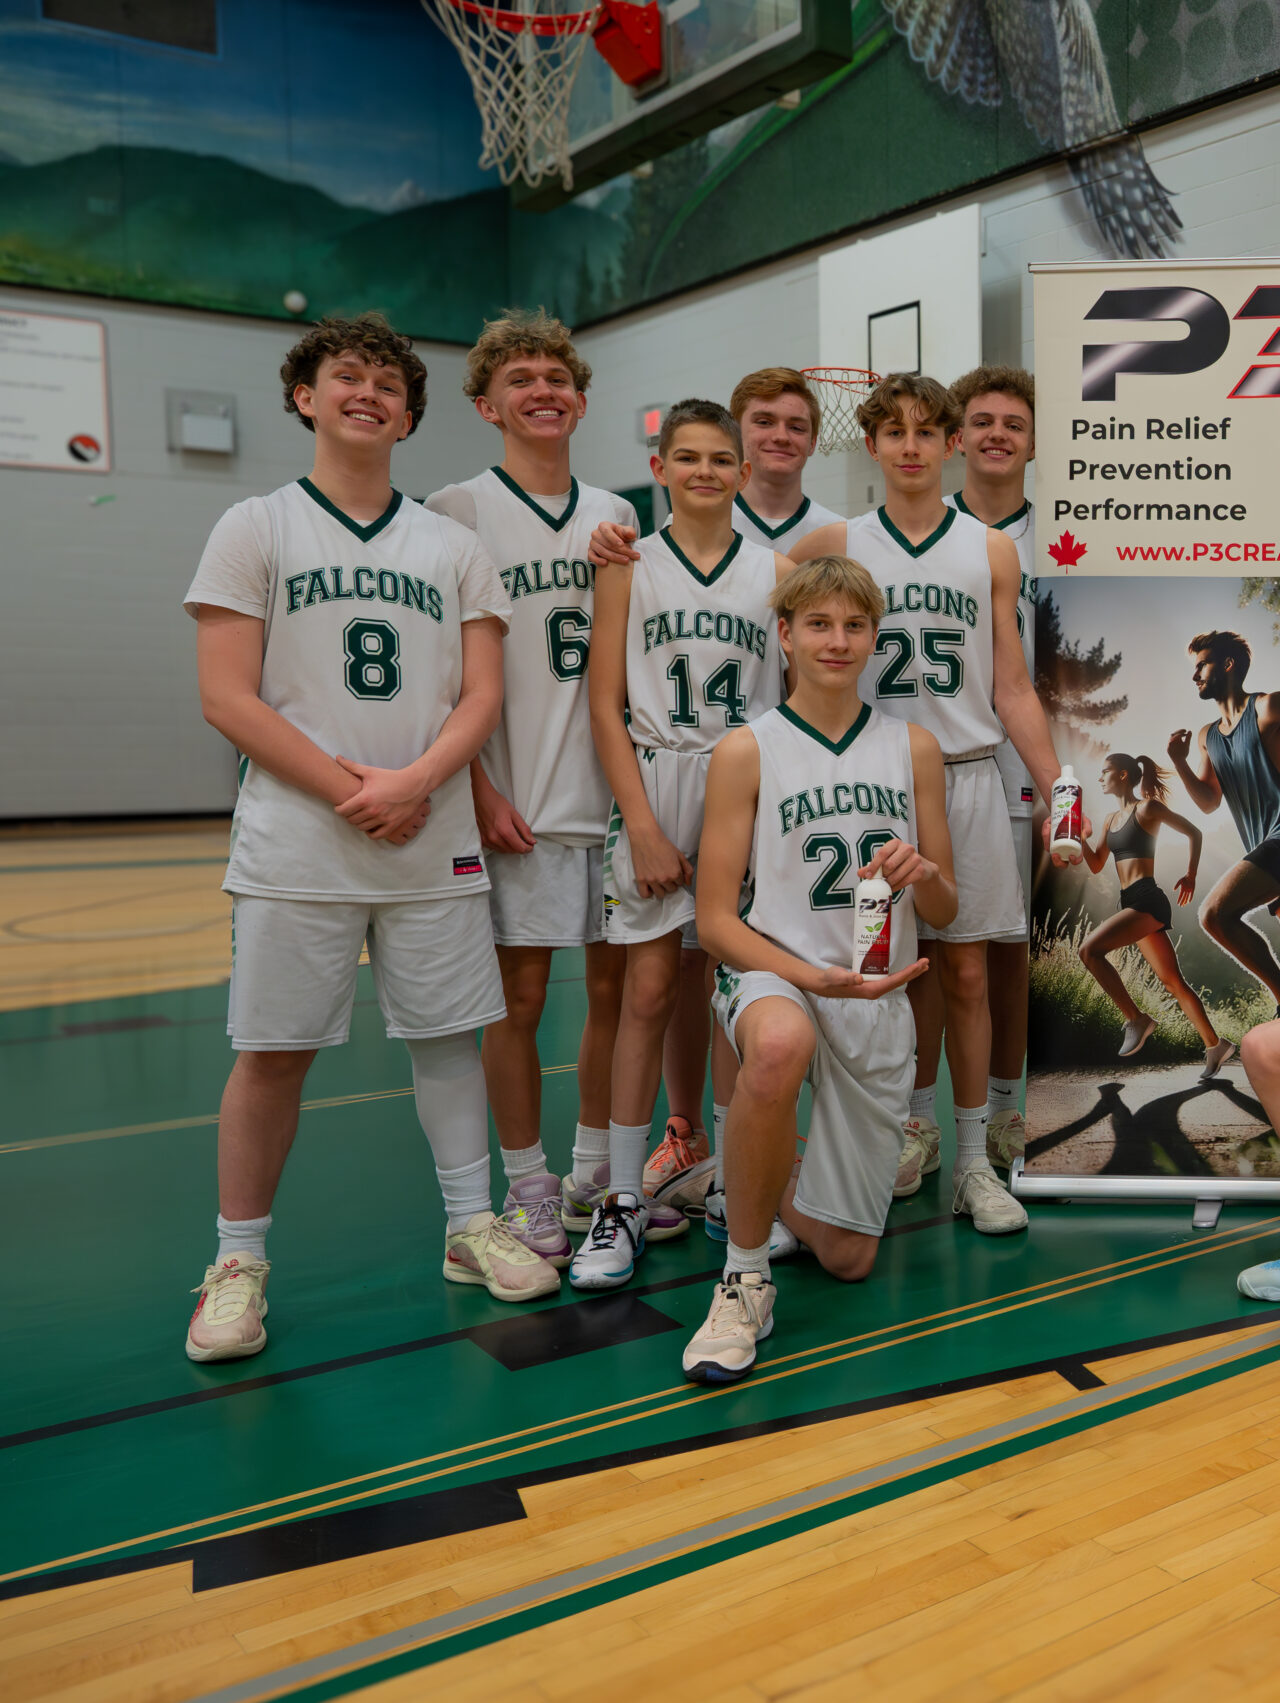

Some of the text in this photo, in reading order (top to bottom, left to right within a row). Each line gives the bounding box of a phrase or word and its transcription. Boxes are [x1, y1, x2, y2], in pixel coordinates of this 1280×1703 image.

[1071, 416, 1231, 440] Pain Relief
[1068, 457, 1232, 481] Prevention
[1054, 498, 1247, 521] Performance
[285, 566, 444, 625] FALCONS
[499, 558, 597, 602] FALCO
[882, 582, 978, 630] LCONS
[343, 617, 402, 702] 8
[545, 606, 593, 683] 6
[643, 609, 767, 662] FALCONS
[666, 654, 748, 728] 14
[874, 627, 965, 700] 25
[778, 781, 909, 838] FALCONS
